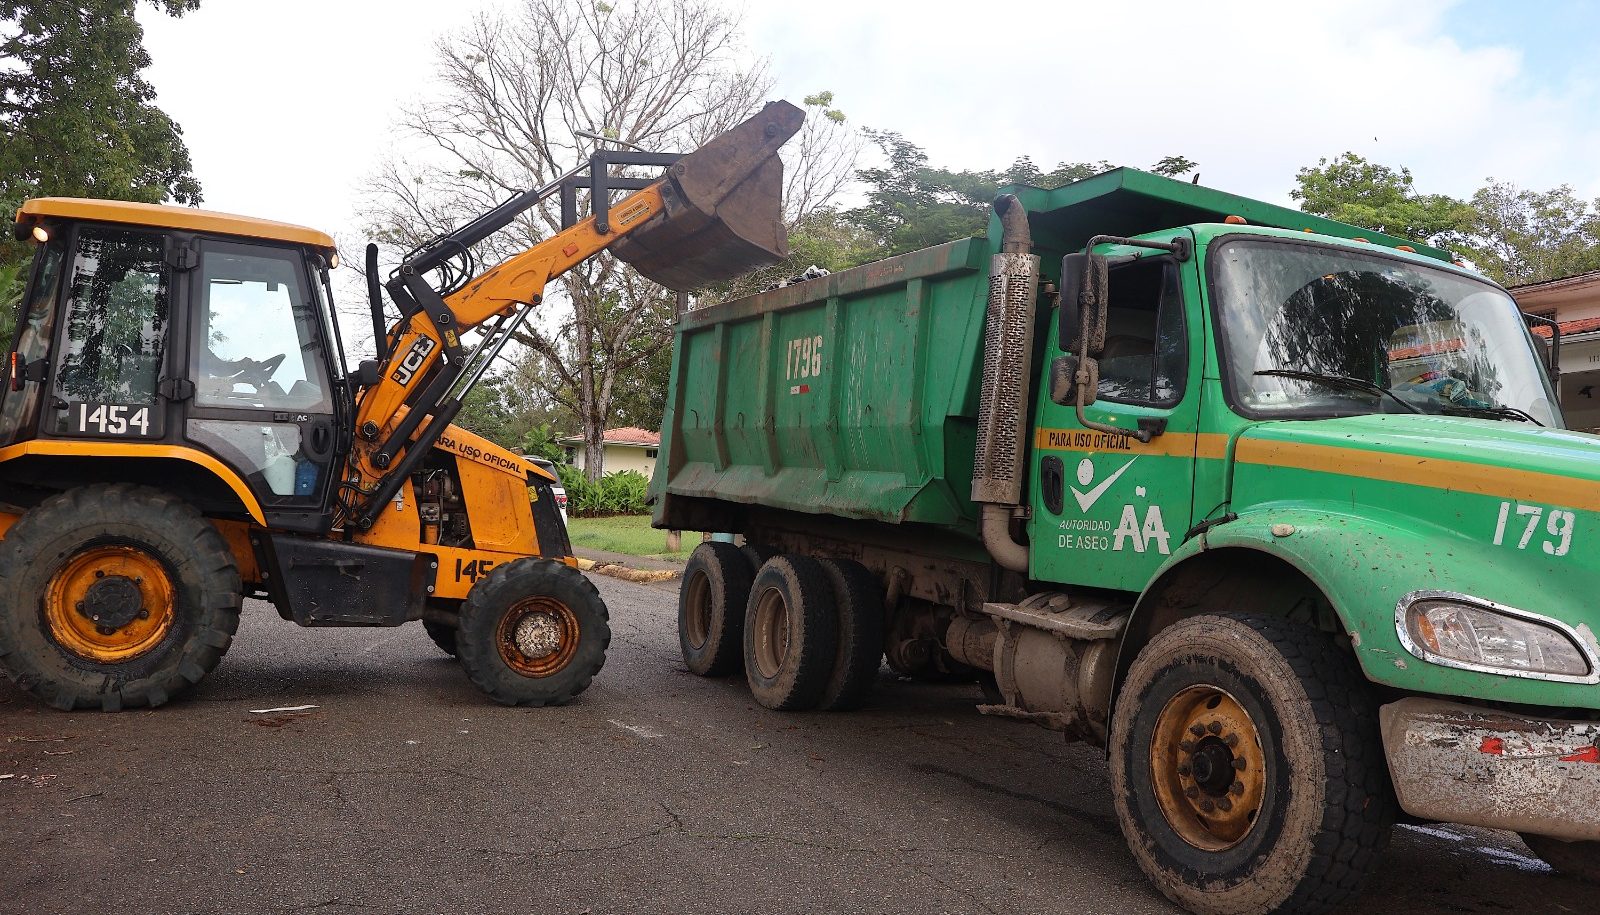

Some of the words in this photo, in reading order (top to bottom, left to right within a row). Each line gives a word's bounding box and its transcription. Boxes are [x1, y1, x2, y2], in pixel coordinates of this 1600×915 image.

[397, 334, 435, 385] JCB
[786, 335, 822, 380] 1796
[80, 403, 149, 435] 1454
[296, 414, 308, 422] AC
[436, 437, 456, 449] ARA
[458, 443, 481, 458] USO
[483, 452, 521, 474] OFICIAL
[1049, 432, 1072, 447] PARA
[1074, 433, 1092, 448] USO
[1093, 433, 1131, 450] OFICIAL
[1058, 520, 1111, 531] AUTORIDAD
[1493, 502, 1576, 557] 179
[1058, 535, 1073, 549] DE
[1075, 535, 1109, 551] ASEO
[455, 558, 494, 584] 145
